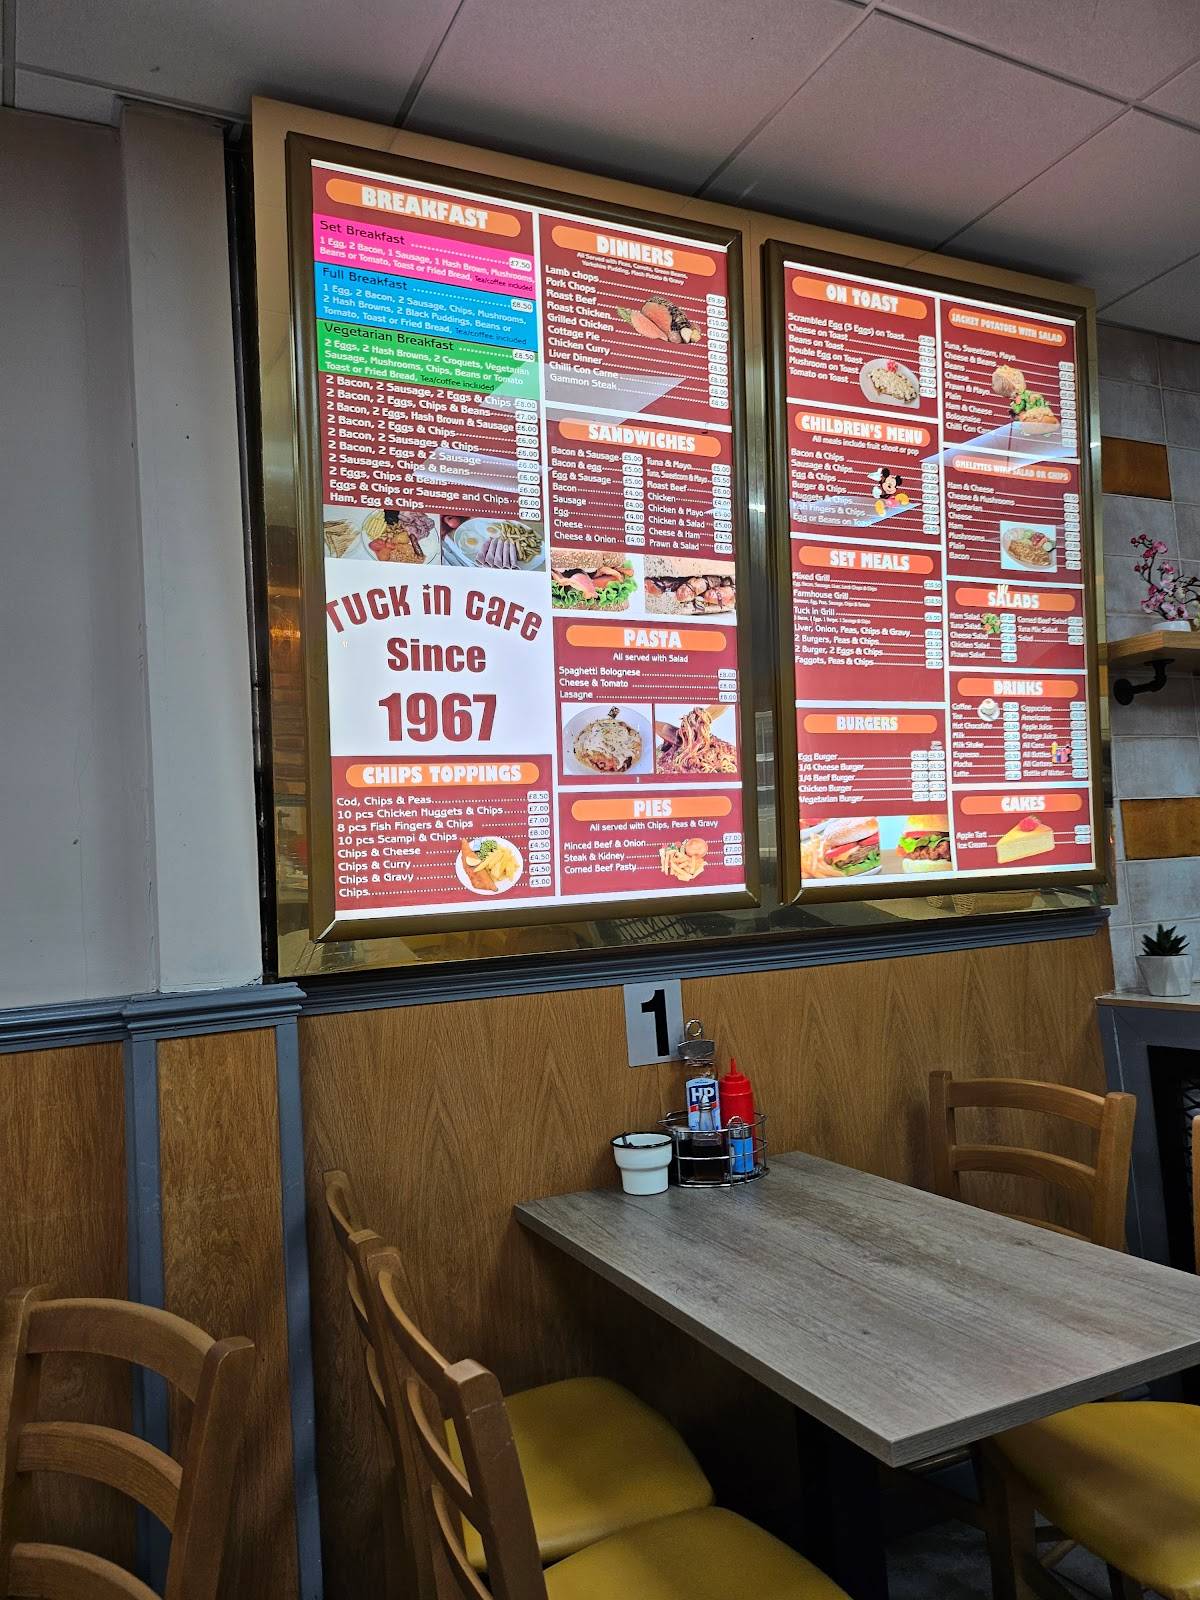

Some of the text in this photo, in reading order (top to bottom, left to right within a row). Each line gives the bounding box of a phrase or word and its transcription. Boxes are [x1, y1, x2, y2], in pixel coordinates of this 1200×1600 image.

[361, 184, 489, 229] BREAKFAST
[320, 220, 342, 233] Set
[347, 225, 406, 245] Breakfast
[596, 235, 674, 267] DINNERS
[546, 264, 570, 278] Lamb
[572, 269, 600, 284] chops
[322, 268, 532, 310] Full Breakfast £8.50
[546, 289, 598, 306] Roast Beef
[826, 284, 899, 314] ON TOAST
[323, 295, 512, 333] 2 Hash Browns, 2 Black Puddings, Beans or
[546, 301, 612, 320] Roast Chicken
[547, 312, 614, 332] Grilled Chicken
[325, 323, 534, 361] Vegetarian Breakfast £8.50
[548, 324, 600, 342] Cottage Pie
[788, 324, 848, 342] Cheese on Toast
[548, 336, 611, 357] Chicken Curry
[550, 373, 618, 392] Gammon Steak
[327, 414, 336, 424] 2
[338, 415, 374, 430] Bacon,
[378, 420, 386, 430] 2
[388, 420, 414, 435] Eggs
[417, 425, 426, 434] &
[428, 426, 456, 440] Chips
[800, 414, 923, 446] CHILDREN'S MENU
[588, 424, 696, 453] SANDWICHES
[790, 448, 845, 463] Bacon & Chips
[330, 479, 356, 493] Eggs
[359, 482, 368, 492] &
[371, 483, 400, 497] Chips
[404, 488, 414, 496] or
[416, 488, 459, 502] Sausage
[462, 492, 480, 502] and
[483, 494, 510, 506] Chips
[646, 480, 668, 492] Roast
[670, 483, 688, 492] Beef
[330, 492, 358, 504] Ham,
[360, 495, 381, 508] Egg
[384, 498, 394, 506] &
[396, 498, 424, 510] Chips
[552, 494, 587, 506] Sausage
[648, 516, 677, 526] Chicken
[678, 518, 686, 527] &
[686, 518, 705, 528] Salad
[554, 532, 584, 542] Cheese
[585, 534, 593, 542] &
[594, 534, 616, 544] Onion
[830, 550, 910, 571] SET MEALS
[988, 588, 1040, 609] SALADS
[326, 584, 411, 633] TUCK
[794, 606, 811, 616] Tuck
[820, 607, 835, 617] Grill
[623, 628, 682, 648] PASTA
[386, 637, 487, 673] Since
[613, 652, 688, 663] All served with Salad
[558, 666, 640, 678] Spaghetti Bolognese
[560, 690, 593, 701] Lasagne
[992, 680, 1044, 696] DRINKS
[378, 692, 497, 742] 1967
[836, 716, 898, 732] BURGERS
[362, 764, 522, 785] CHIPS TOPPINGS
[336, 797, 361, 807] Cod,
[364, 796, 393, 807] Chips
[396, 796, 405, 805] &
[408, 796, 432, 805] Peas
[633, 799, 673, 818] PIES
[1000, 796, 1046, 812] CAKES
[338, 810, 352, 820] 10
[355, 811, 374, 821] pcs
[376, 808, 418, 818] Chicken
[420, 807, 463, 820] Nuggets
[466, 806, 474, 816] &
[476, 806, 504, 816] Chips
[336, 823, 345, 833] 8
[348, 824, 368, 834] pcs
[370, 822, 392, 832] Fish
[394, 821, 432, 832] Fingers
[435, 820, 444, 830] &
[446, 820, 474, 830] Chips
[590, 819, 718, 832] All served with Chips, Peas & Gravy
[338, 836, 352, 846] 10
[356, 837, 375, 847] pcs
[378, 834, 416, 846] Scampi
[418, 833, 428, 842] &
[430, 832, 458, 842] Chips
[564, 839, 646, 852] Minced Beef & Onion
[338, 848, 368, 860] Chips
[370, 848, 380, 857] &
[383, 846, 422, 856] Cheese
[594, 864, 614, 872] Beef
[616, 863, 636, 873] Pasty
[338, 872, 414, 886] Chips & Gravy
[641, 988, 670, 1058] 1
[691, 1086, 715, 1102] HP
